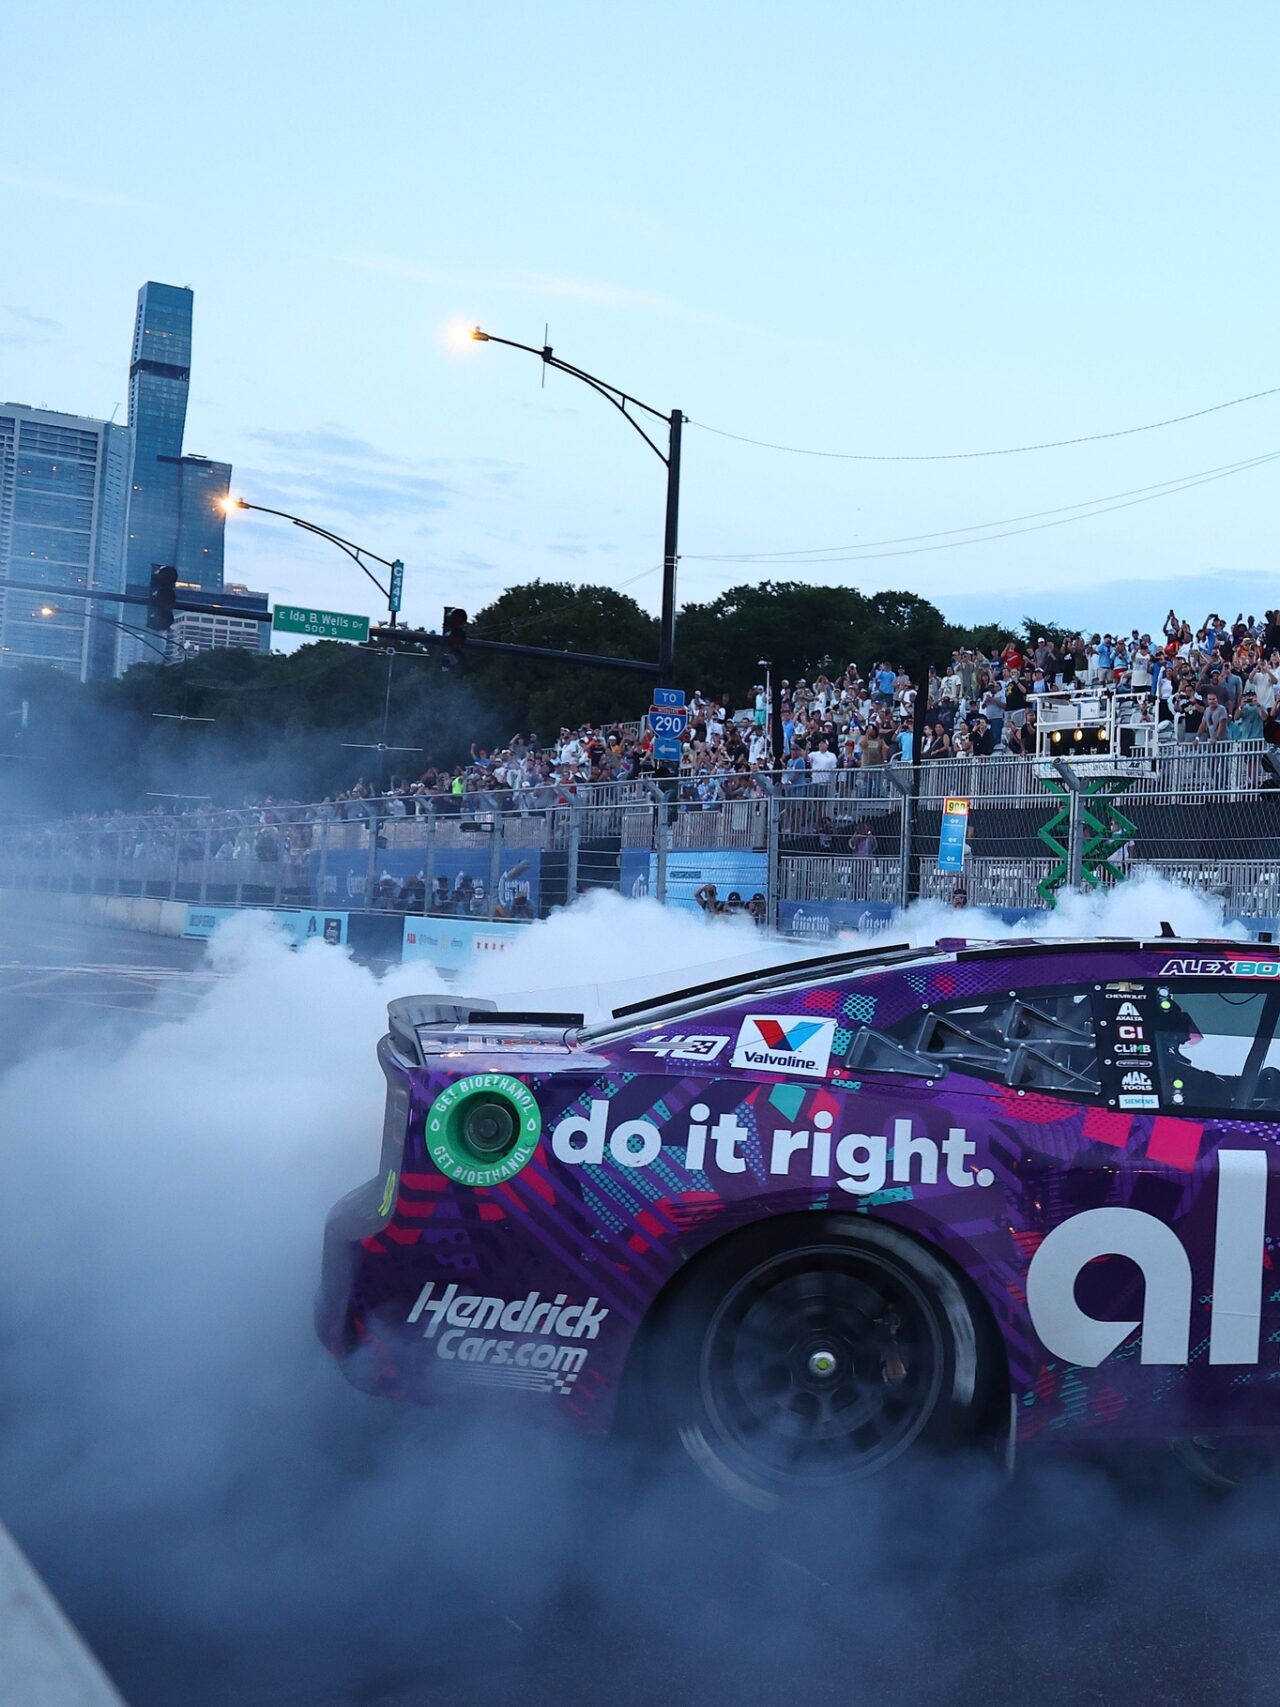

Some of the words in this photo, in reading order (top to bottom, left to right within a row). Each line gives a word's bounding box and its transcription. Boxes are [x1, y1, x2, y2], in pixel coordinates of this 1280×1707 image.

[290, 610, 305, 622] Ida
[322, 614, 349, 627] Wells
[352, 620, 363, 629] Dr
[304, 624, 326, 634] 500
[331, 627, 337, 635] S
[662, 692, 677, 703] TO
[655, 716, 681, 733] 290
[744, 1051, 817, 1070] Valvoline
[1121, 1071, 1152, 1085] MAC
[435, 1088, 459, 1112] GET
[459, 1075, 535, 1116] BIOETHANOL
[551, 1099, 662, 1168] do
[685, 1103, 748, 1174] it
[769, 1110, 995, 1194] right.
[433, 1145, 454, 1169] GET
[452, 1147, 530, 1184] BIOETHANOL
[406, 1281, 609, 1339] Hendrick
[436, 1329, 588, 1373] Cars.com
